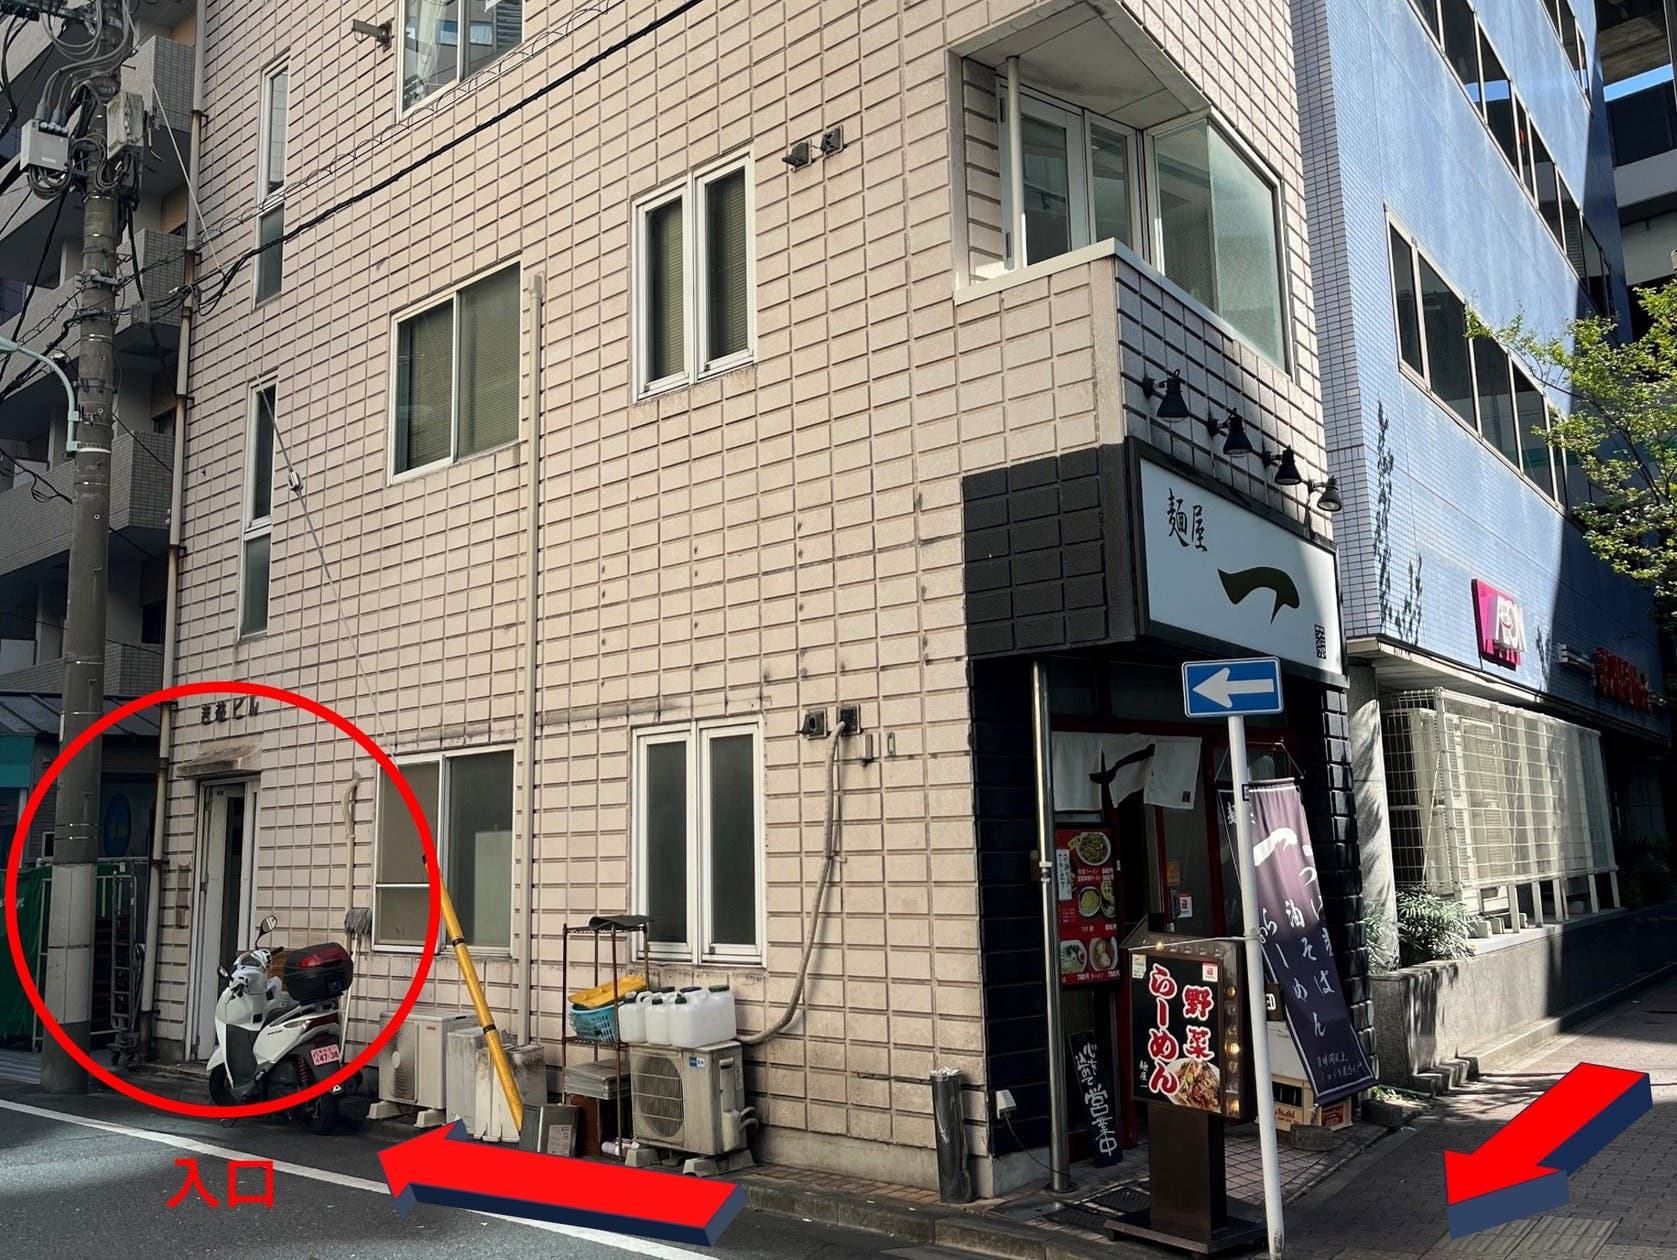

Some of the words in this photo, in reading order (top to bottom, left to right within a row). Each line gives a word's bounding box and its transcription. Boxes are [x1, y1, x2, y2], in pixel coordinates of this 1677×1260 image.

[1149, 962, 1180, 1096] らーめん
[1182, 984, 1215, 1062] 野菜
[1085, 1083, 1118, 1157] 営業中
